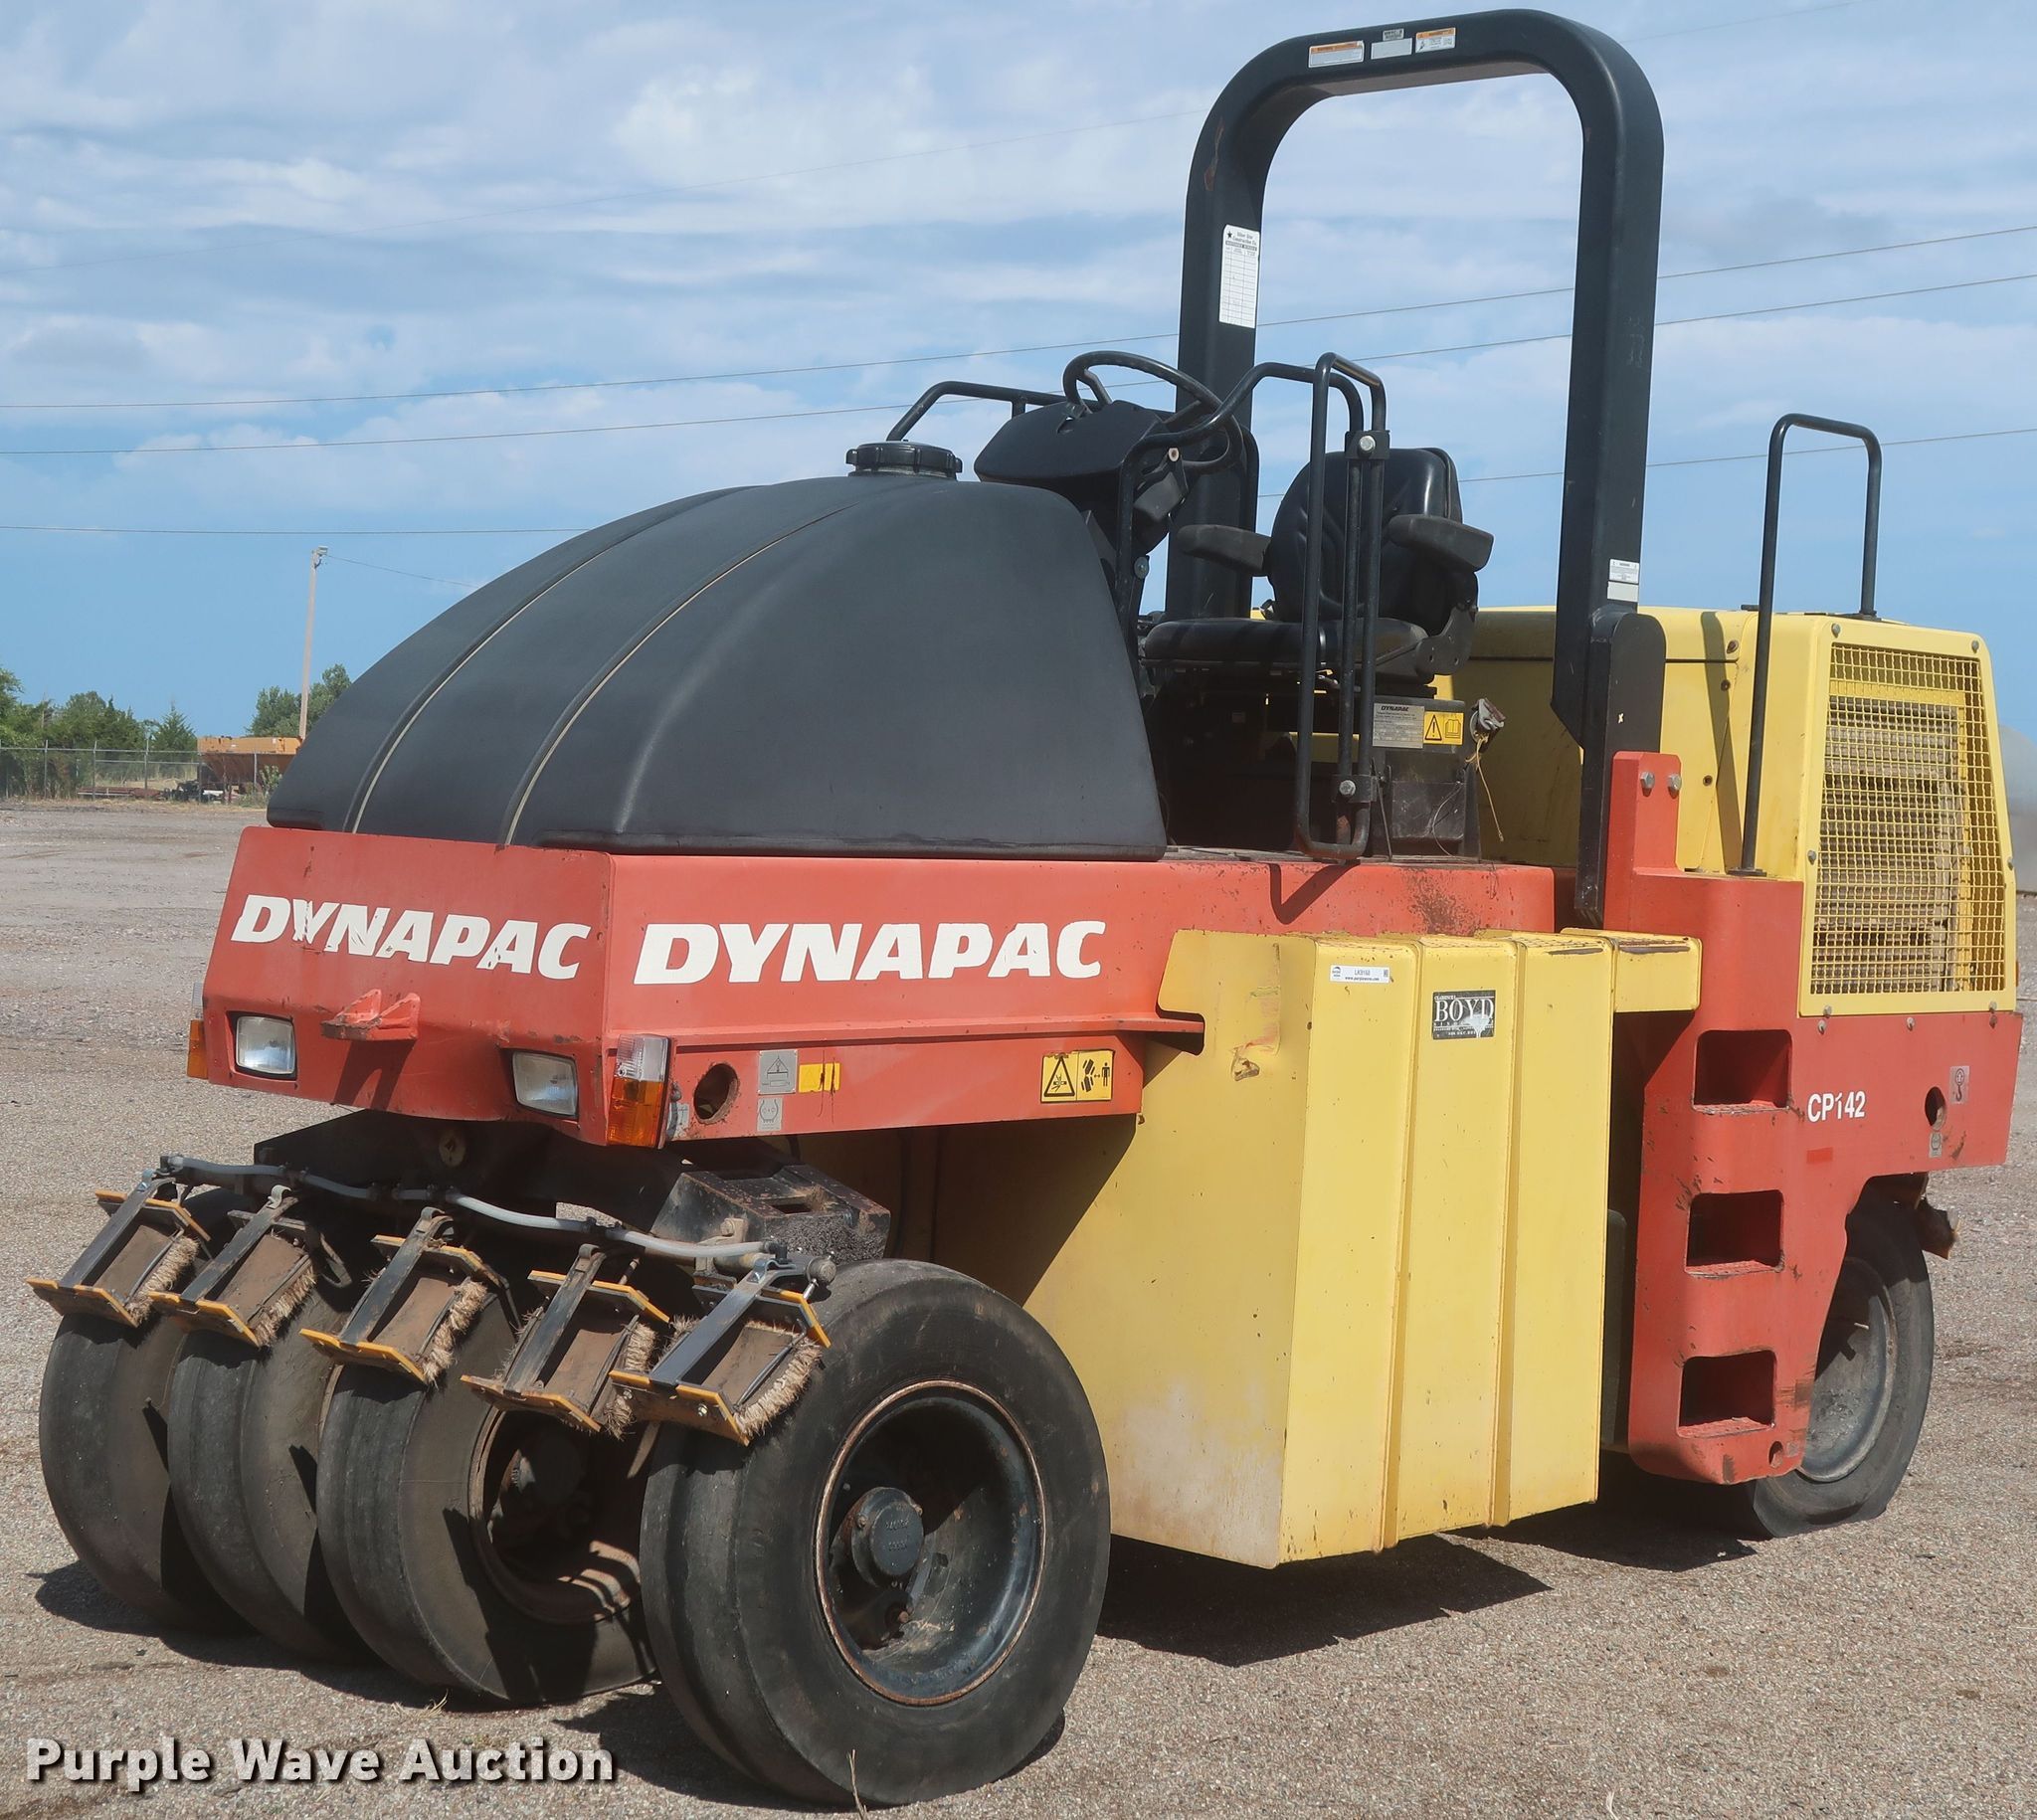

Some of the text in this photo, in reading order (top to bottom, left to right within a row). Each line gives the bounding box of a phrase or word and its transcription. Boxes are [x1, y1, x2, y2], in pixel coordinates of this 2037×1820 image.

[230, 894, 592, 980] DYNAPAC
[634, 921, 1106, 986] DYNAPAC
[1434, 999, 1494, 1022] BOYD
[1807, 1090, 1866, 1123] CP142
